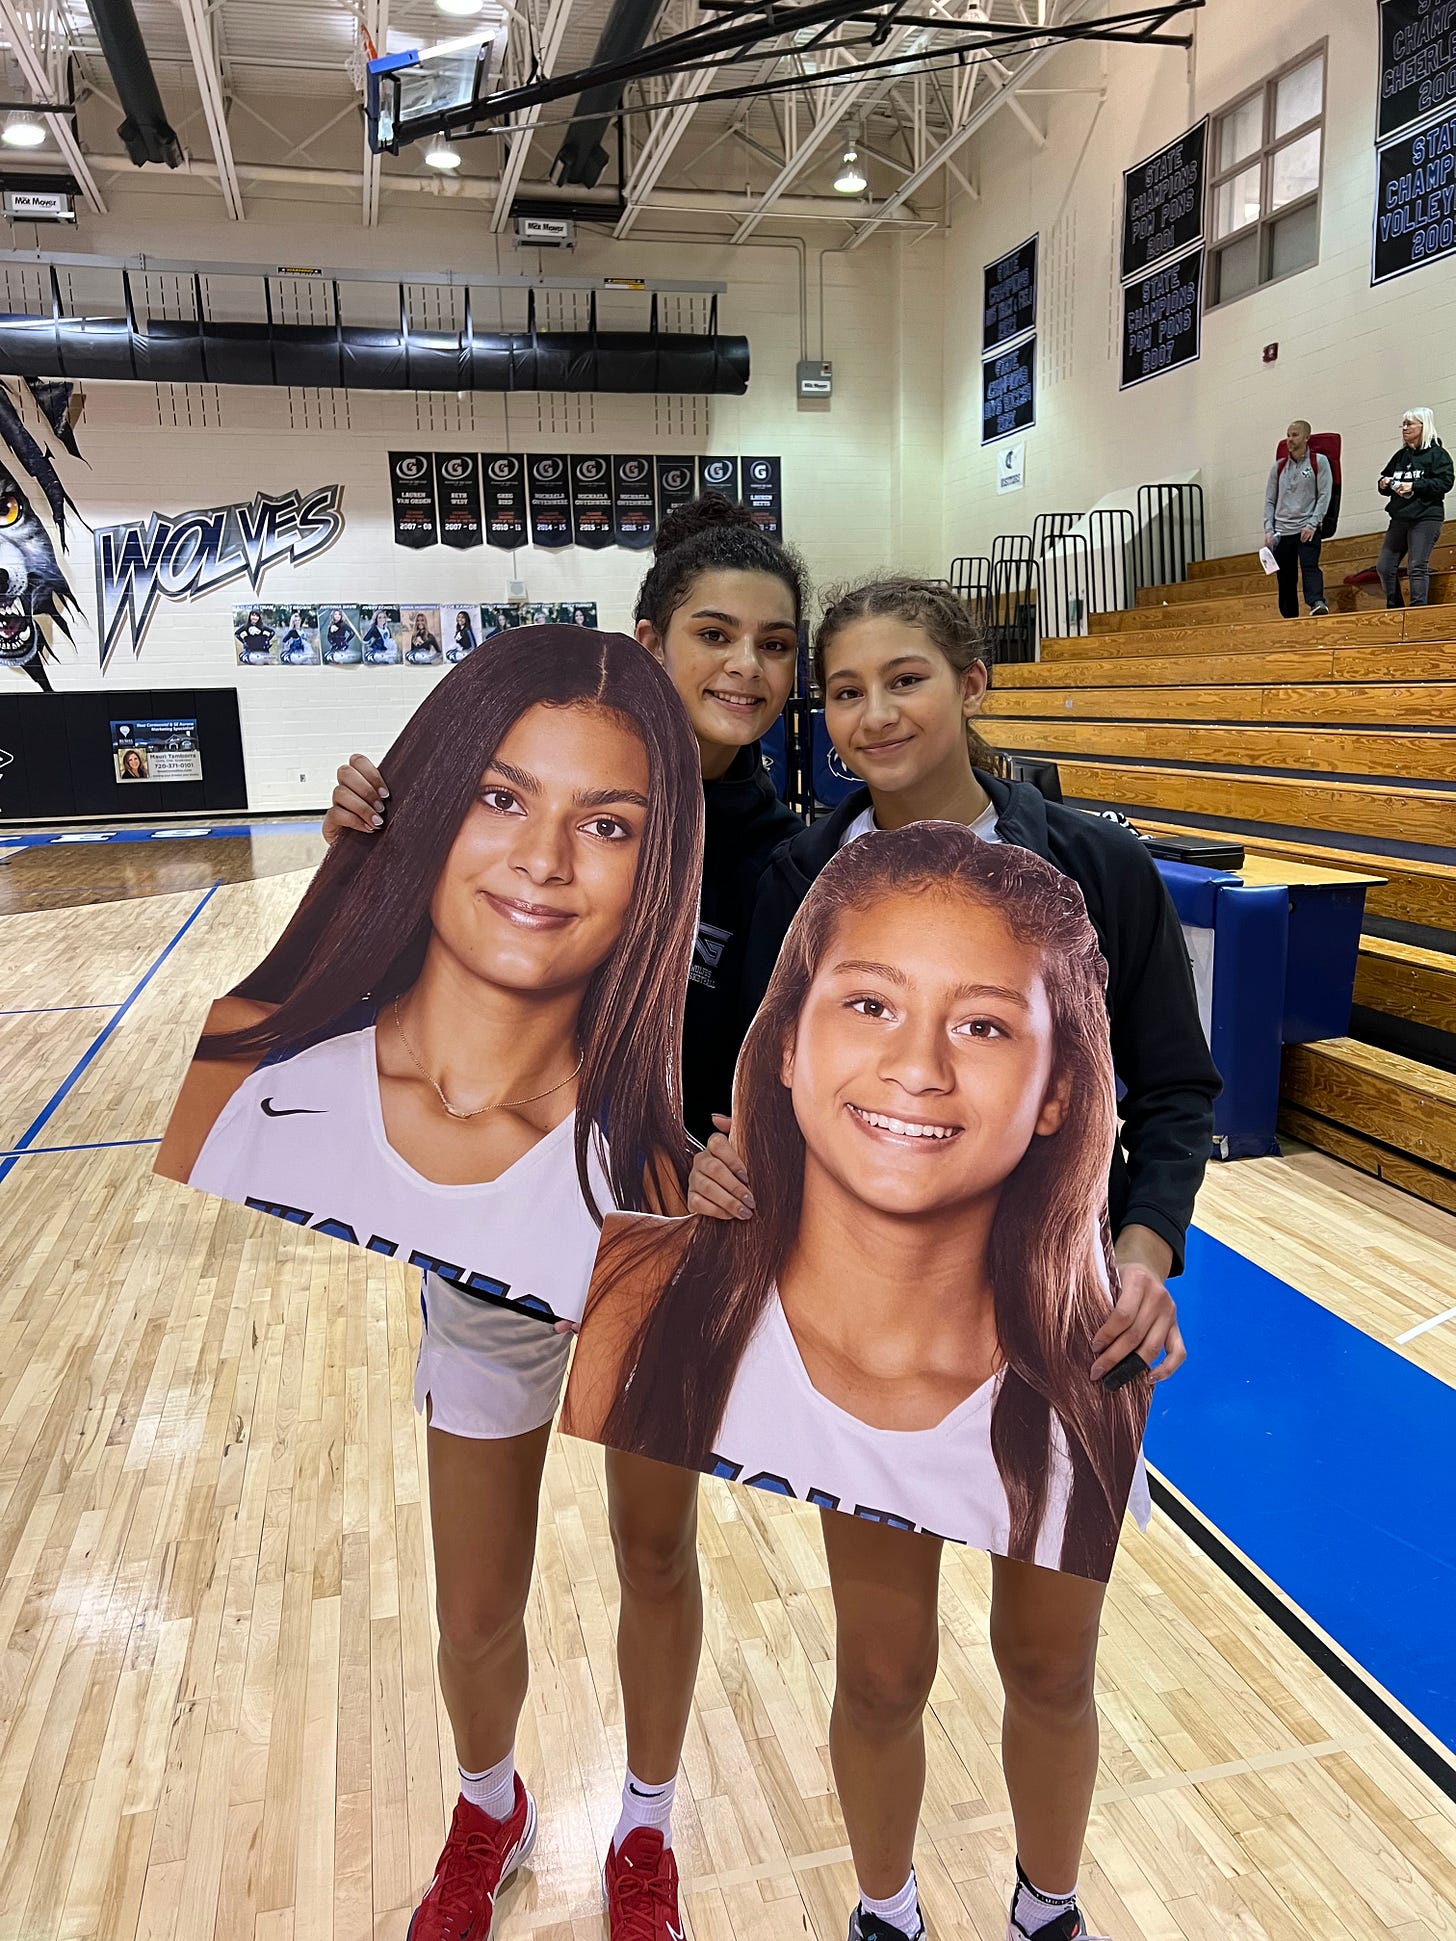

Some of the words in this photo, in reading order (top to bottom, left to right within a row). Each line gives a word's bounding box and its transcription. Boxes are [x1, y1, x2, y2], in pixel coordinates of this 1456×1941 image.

[1131, 160, 1197, 220] CHAMPIONS
[1145, 144, 1184, 187] STATE
[1386, 153, 1456, 208] CHAMP
[1132, 212, 1155, 244] POM
[1161, 188, 1195, 227] PONS
[1380, 184, 1456, 242] VOLLEY
[1411, 217, 1456, 260] 200
[1128, 281, 1195, 333] CHAMPIONS
[1143, 264, 1180, 303] STATE
[1129, 326, 1152, 356] POM
[1158, 308, 1192, 343] PONS
[93, 484, 345, 677] WOLVES
